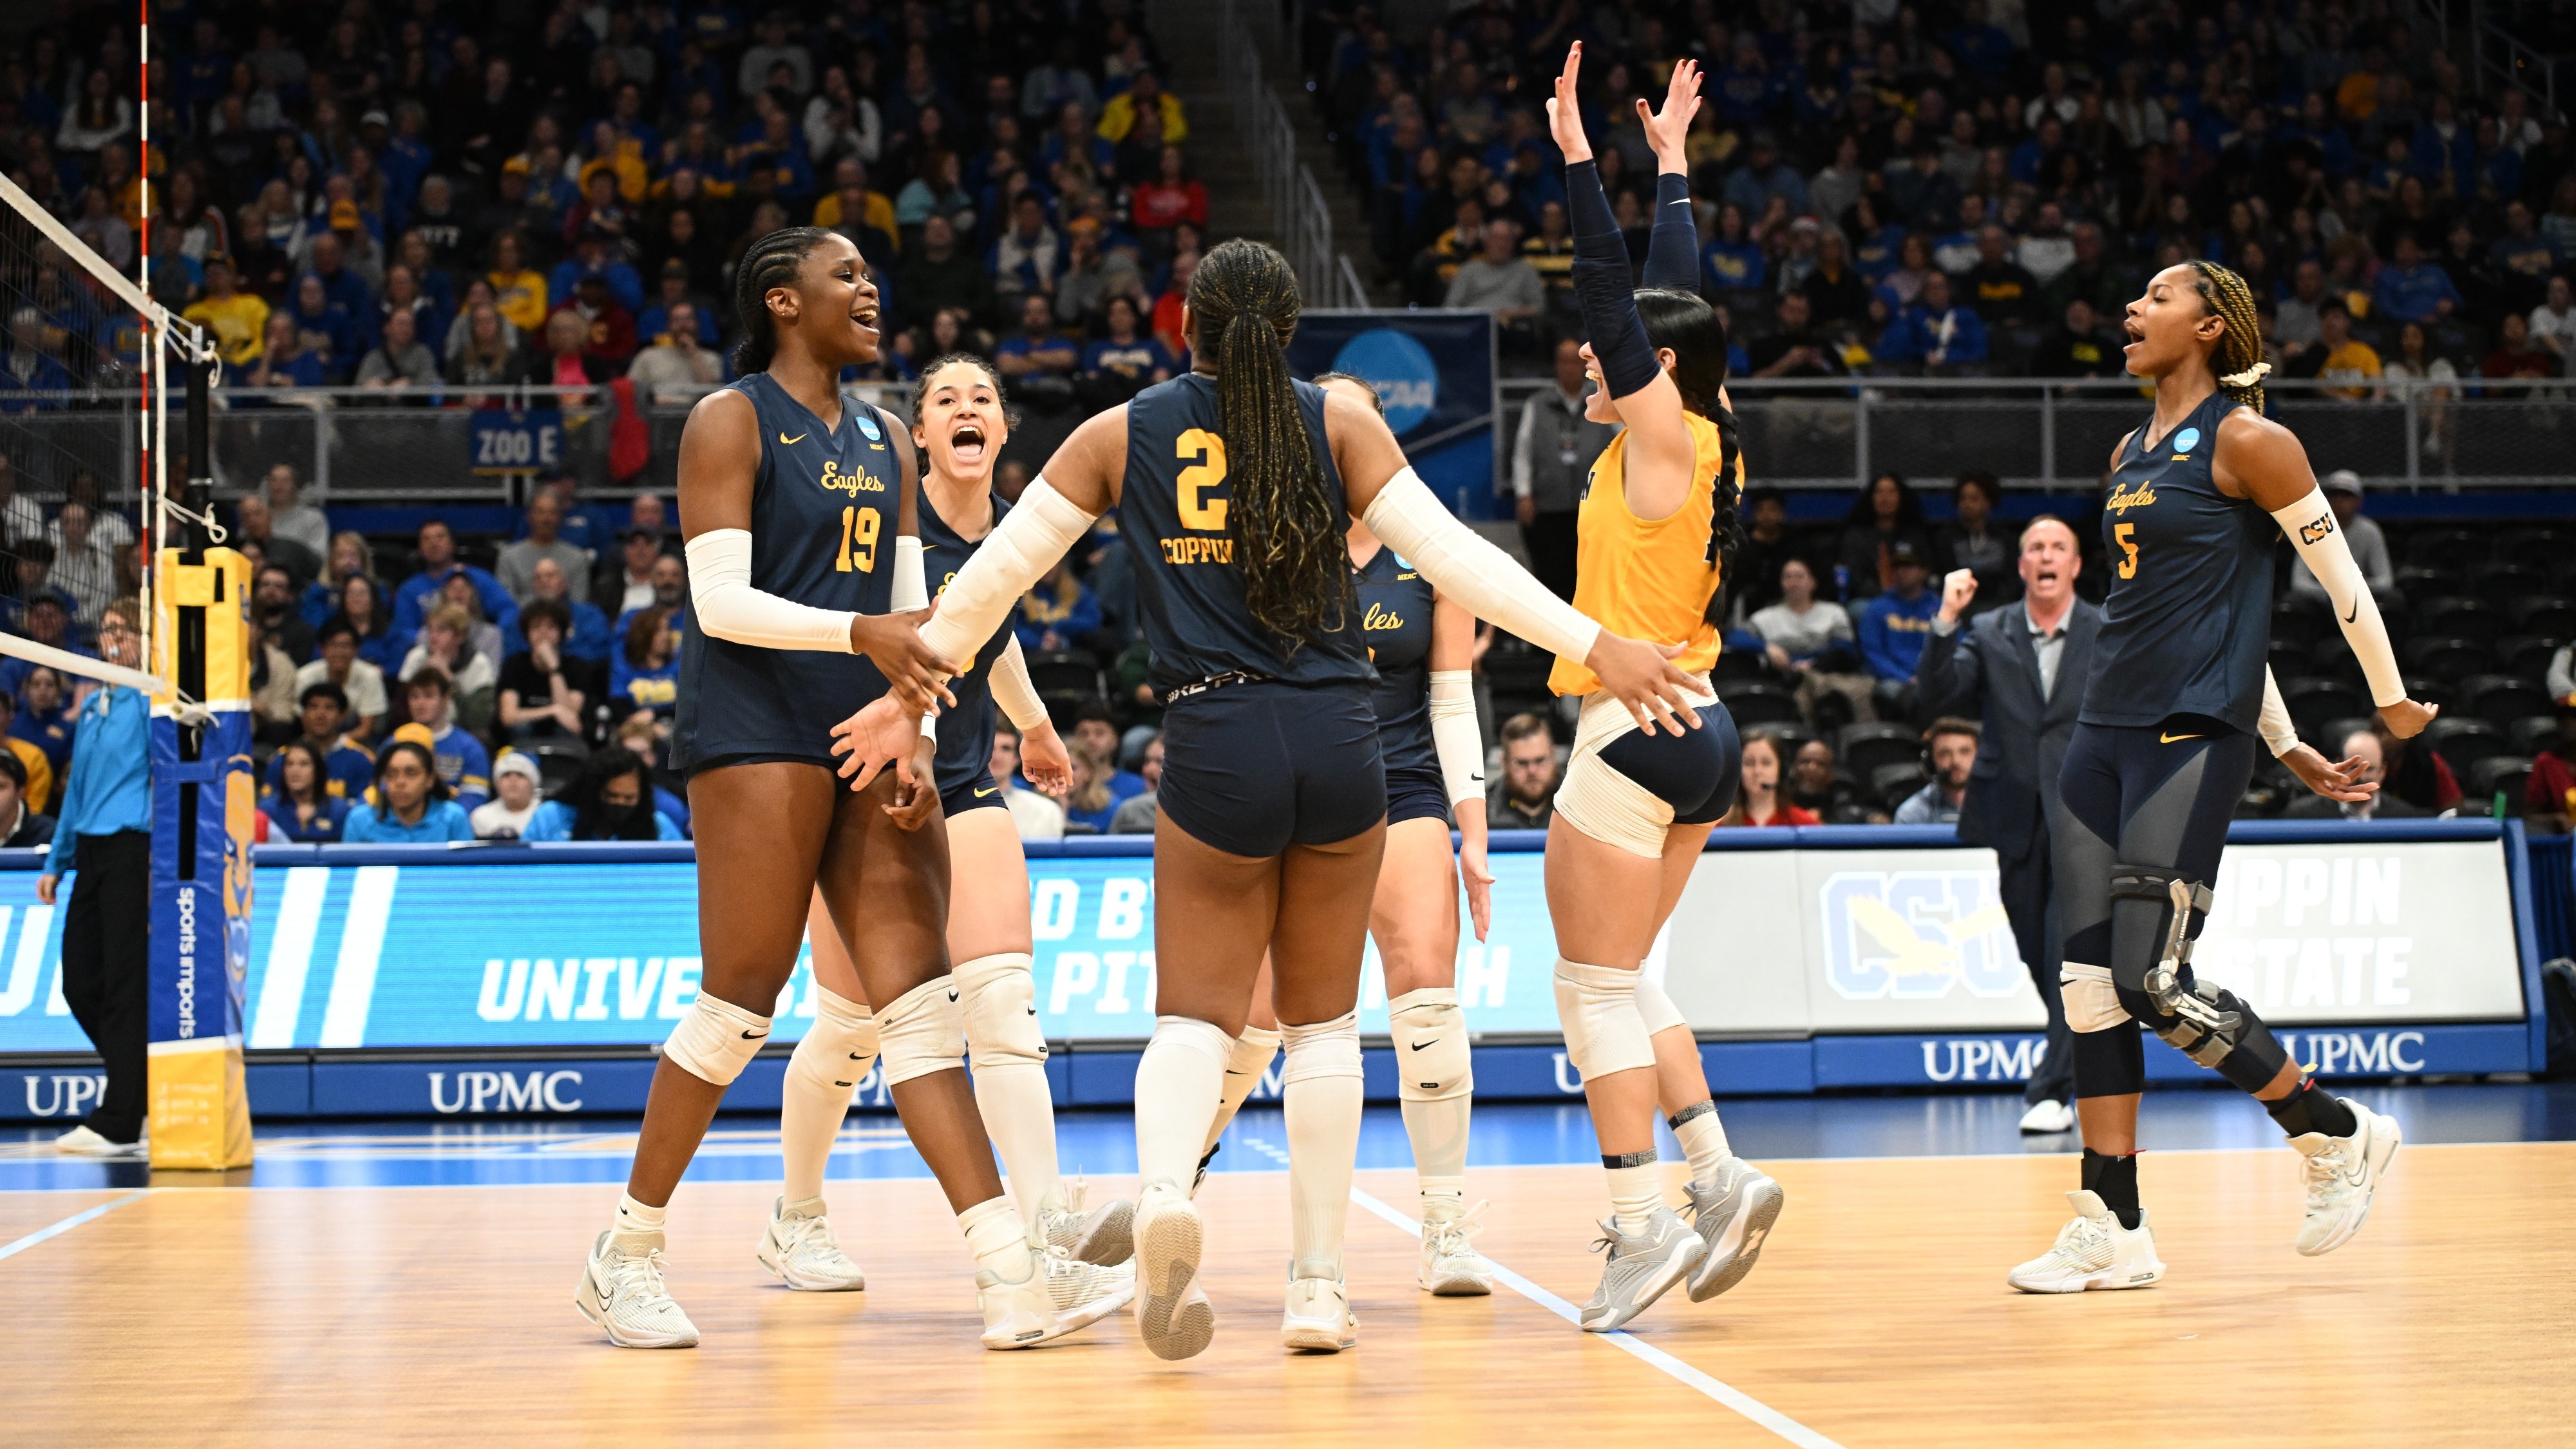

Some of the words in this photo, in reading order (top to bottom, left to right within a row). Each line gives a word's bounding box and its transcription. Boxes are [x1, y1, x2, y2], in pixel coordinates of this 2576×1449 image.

[1374, 381, 1434, 408] CAA
[478, 428, 531, 464] ZOO
[539, 426, 558, 463] E
[821, 461, 885, 498] Eagles
[1176, 428, 1227, 531] 2
[2107, 480, 2157, 516] Eagles
[836, 506, 881, 573] 19
[2299, 511, 2334, 545] CSU
[1160, 536, 1234, 564] COPPIN
[2114, 522, 2139, 579] 5
[1397, 572, 1417, 581] MEAC
[1363, 602, 1404, 630] les
[1096, 878, 1155, 940] B
[2215, 857, 2401, 927] PPIN
[176, 887, 196, 954] sports
[1819, 870, 2028, 1000] CSU
[2213, 937, 2412, 1007] STATE
[176, 956, 196, 1039] imports
[2280, 1032, 2425, 1074] UPMC
[23, 1075, 108, 1117] UP
[428, 1070, 583, 1113] UPMC
